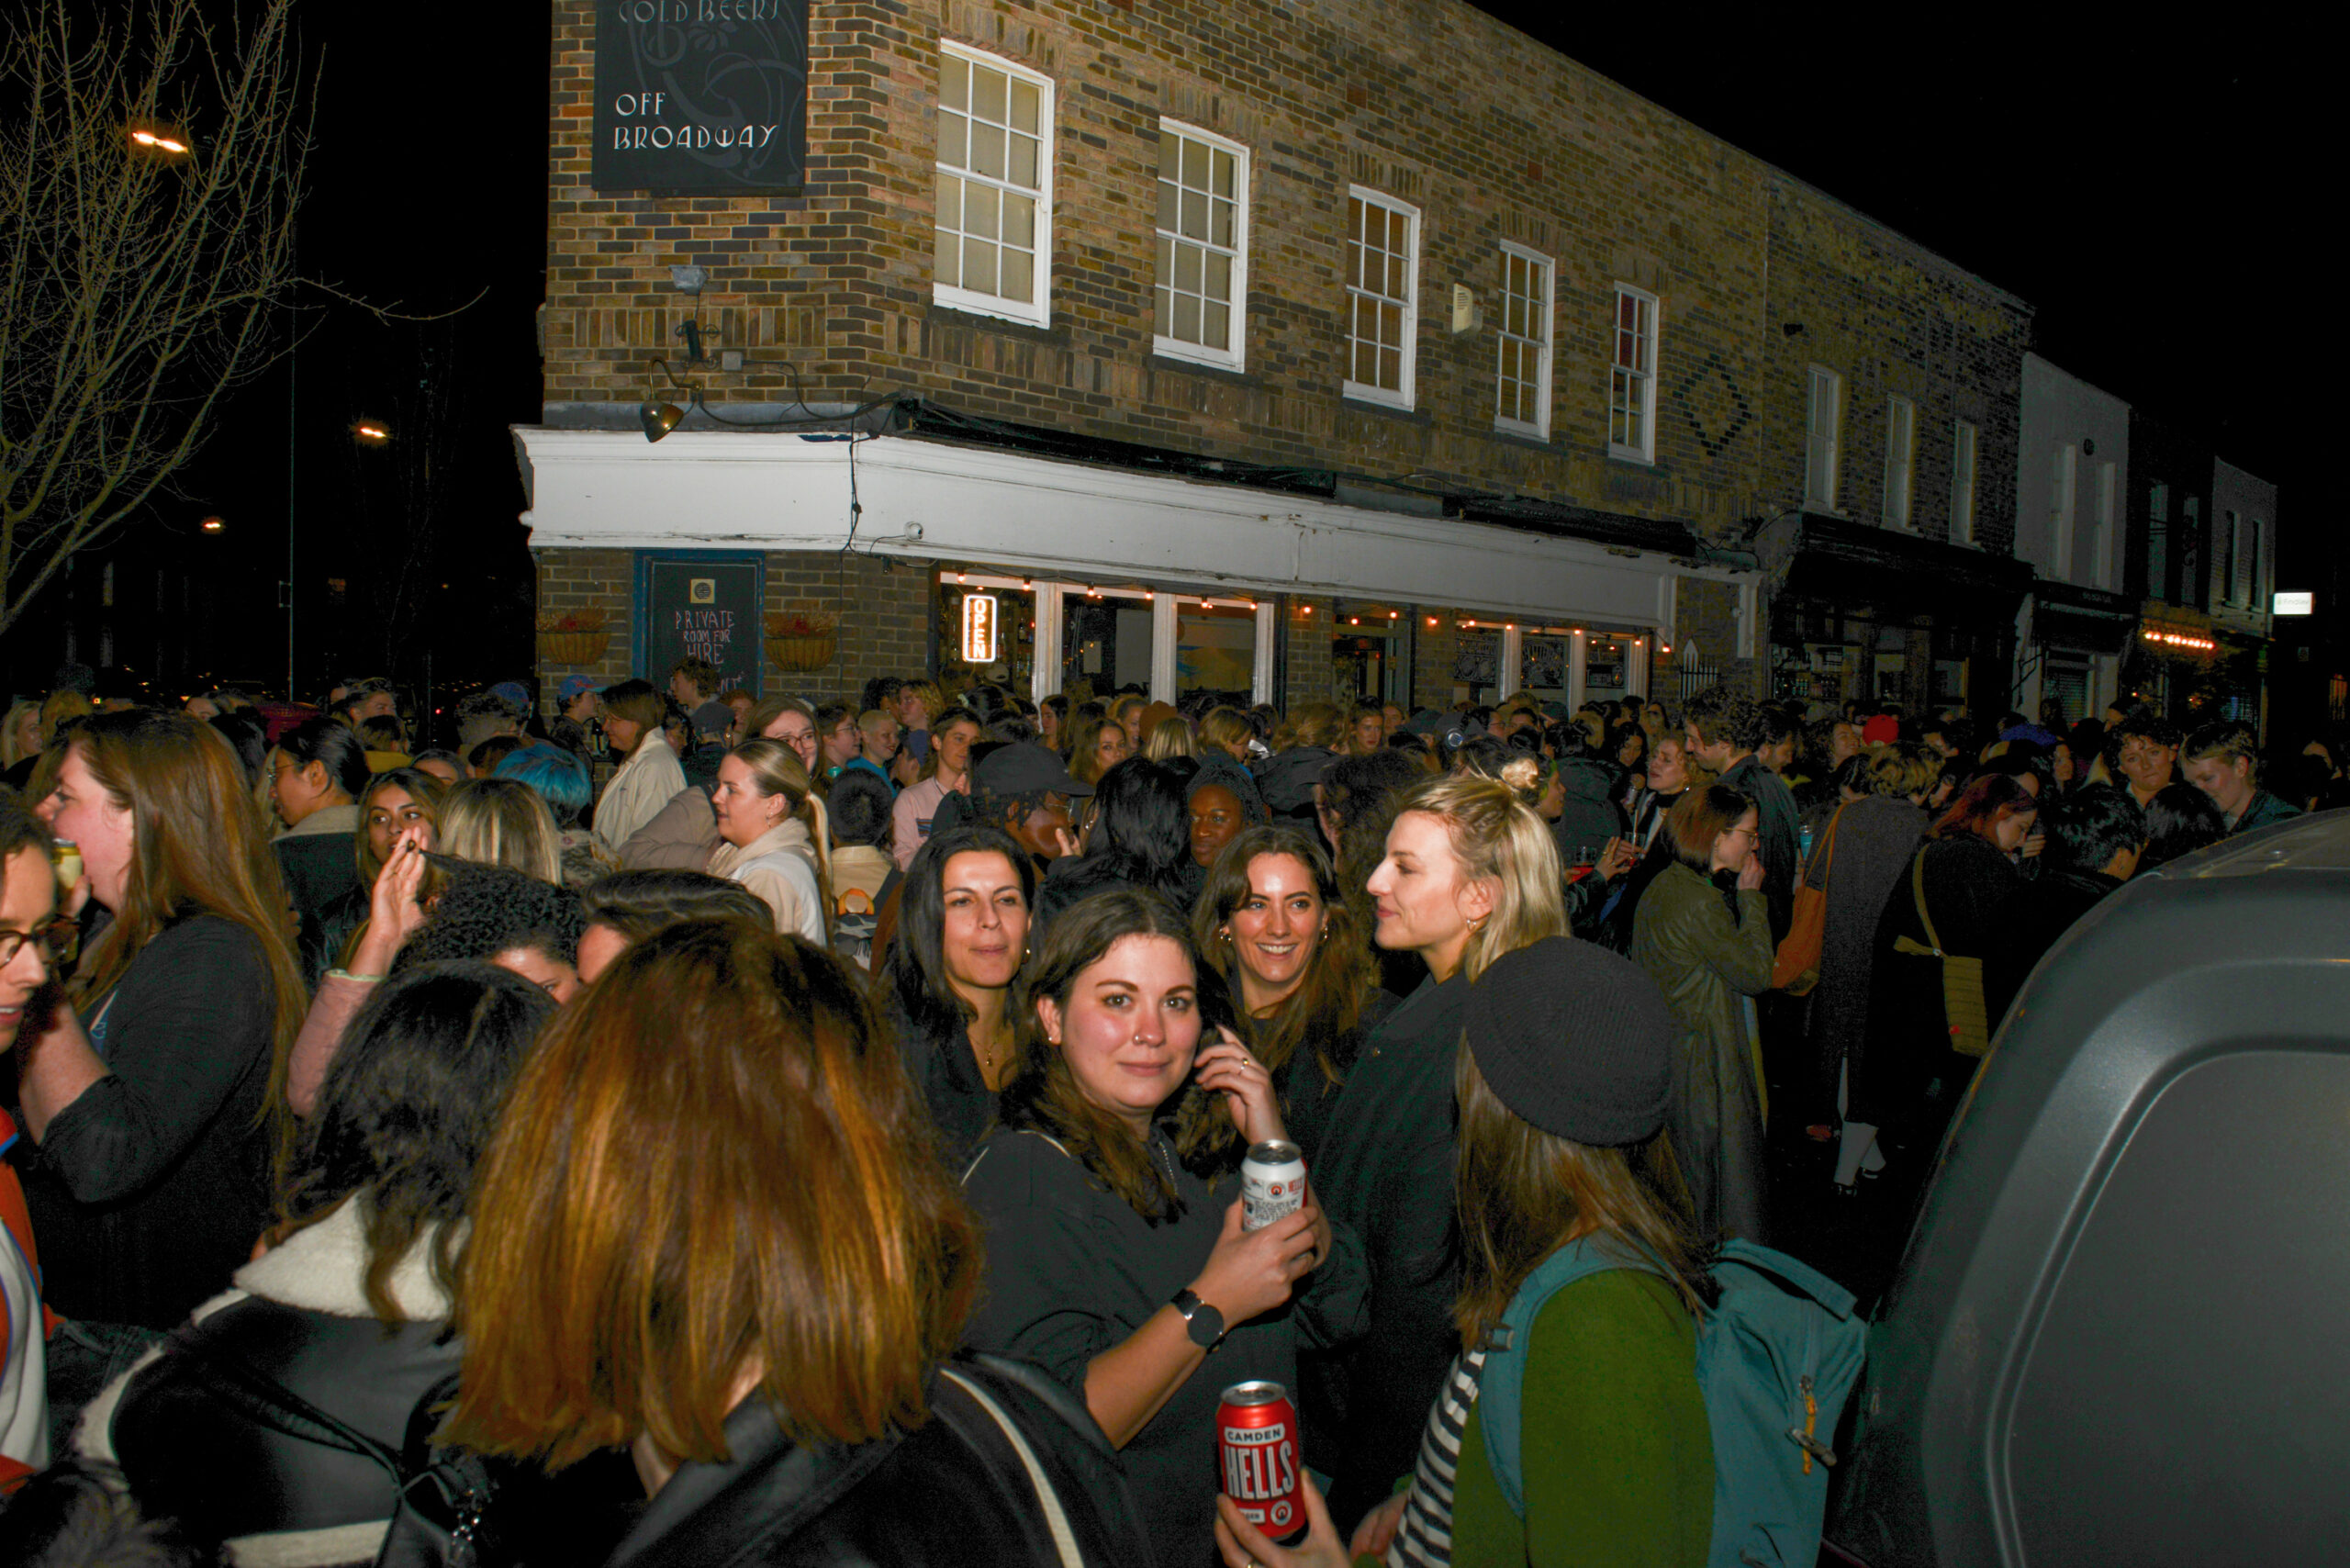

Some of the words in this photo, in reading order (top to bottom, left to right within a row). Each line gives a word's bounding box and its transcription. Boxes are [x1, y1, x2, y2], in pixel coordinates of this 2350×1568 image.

[619, 0, 689, 23] COLD
[615, 92, 666, 117] OFF
[613, 125, 778, 150] BROADWAY
[676, 610, 734, 629] PRIVATE
[973, 599, 987, 658] OPEN
[683, 630, 711, 643] ROOM
[713, 629, 732, 643] FOR
[687, 644, 724, 666] HIRE
[1227, 1428, 1281, 1441] CAMDEN
[1224, 1439, 1295, 1500] HELLS
